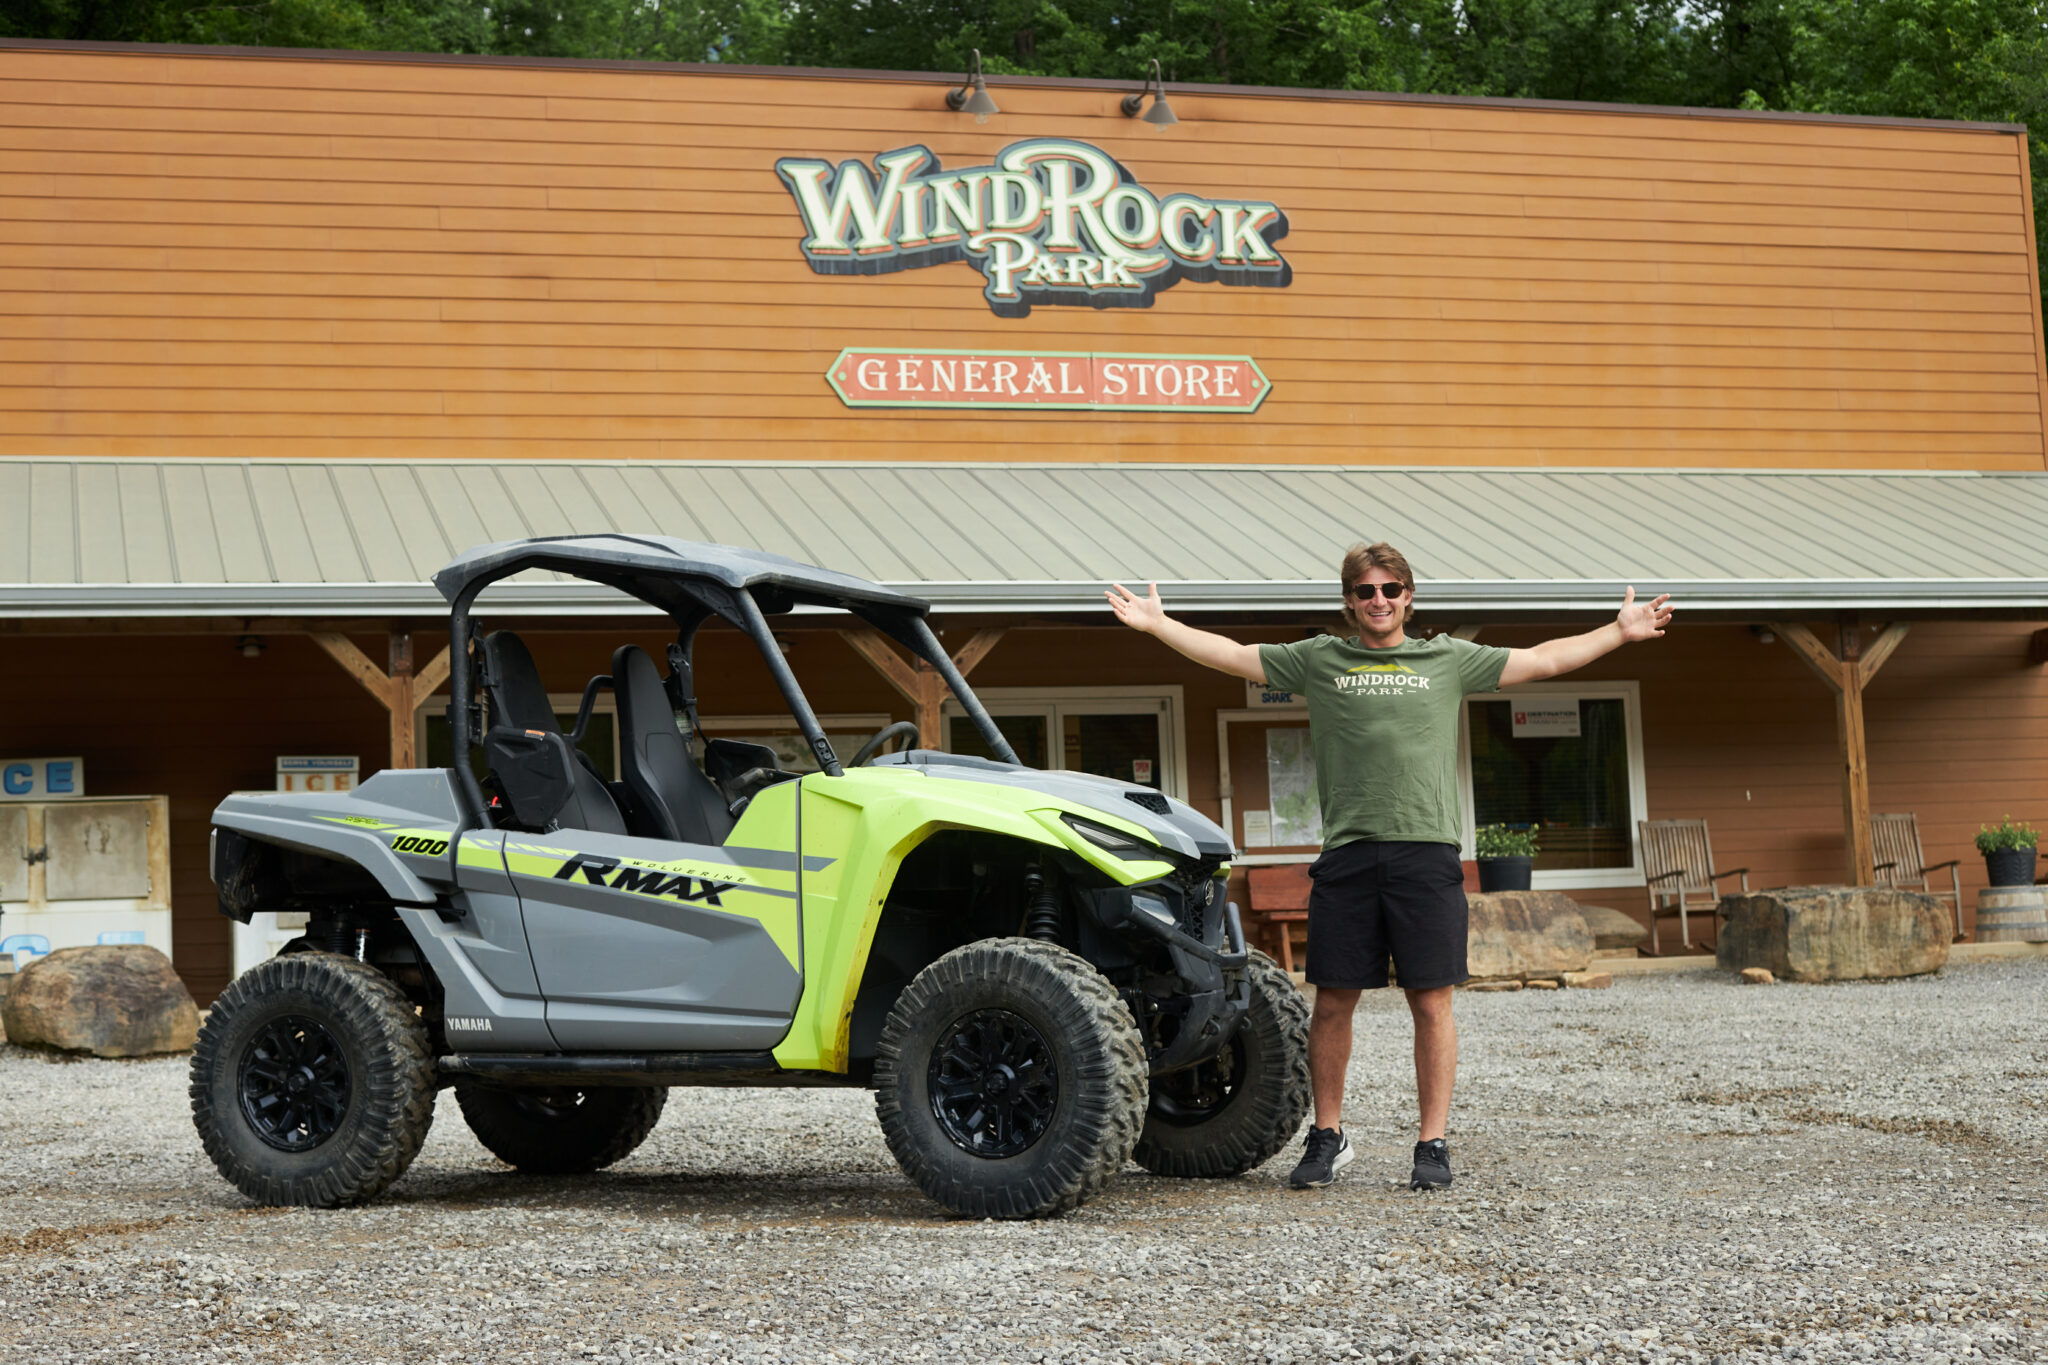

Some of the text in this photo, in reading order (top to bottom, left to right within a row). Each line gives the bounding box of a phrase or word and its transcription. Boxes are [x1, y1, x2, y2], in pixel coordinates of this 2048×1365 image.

[967, 232, 1144, 298] PARK
[857, 357, 1242, 400] GENERAL STORE
[1333, 673, 1431, 690] WINDROCK
[1261, 692, 1294, 704] SHARE
[1356, 687, 1404, 696] PARK
[284, 774, 351, 792] ICE
[391, 835, 450, 856] 1000
[553, 852, 740, 908] RMAX
[446, 1017, 493, 1032] YAMAHA
